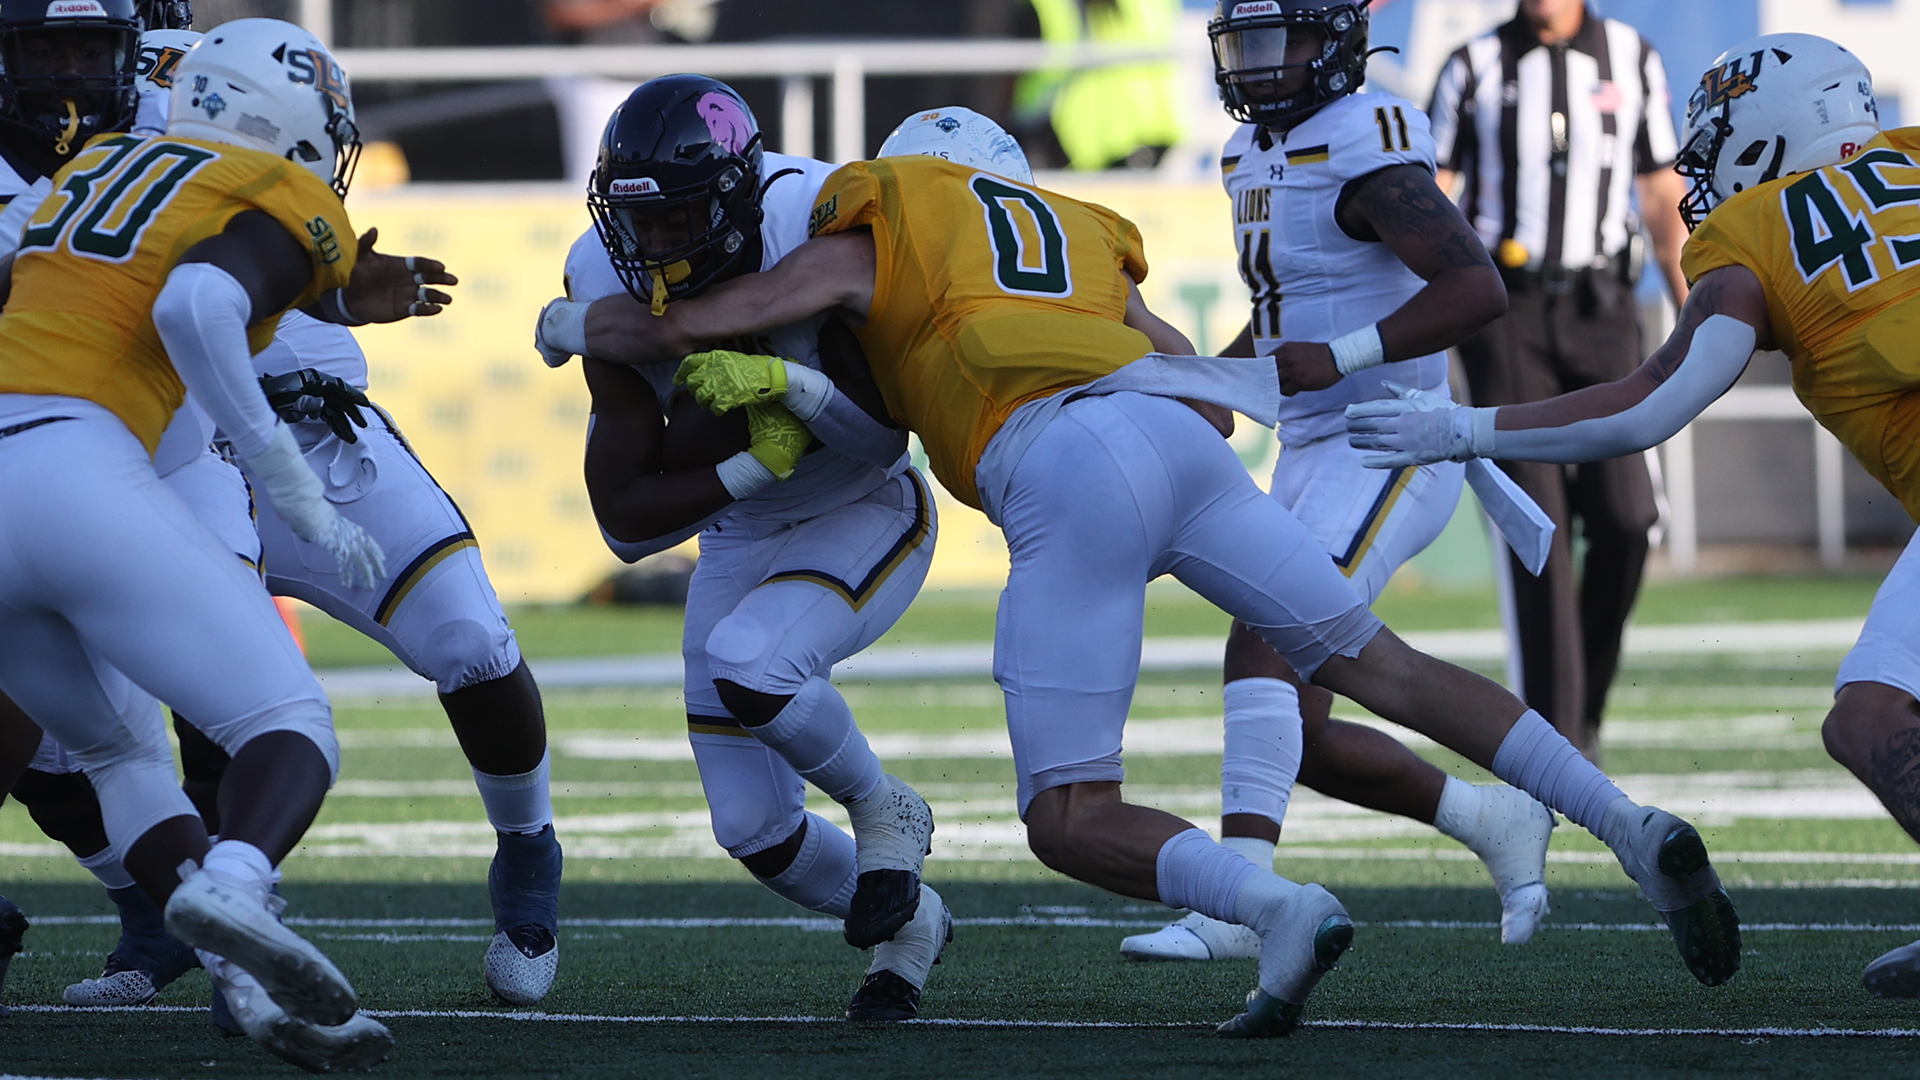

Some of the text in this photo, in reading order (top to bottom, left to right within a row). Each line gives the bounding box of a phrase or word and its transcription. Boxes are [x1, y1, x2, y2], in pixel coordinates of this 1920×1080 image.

[1236, 3, 1273, 14] Riddell
[136, 46, 186, 89] SL
[921, 112, 940, 122] 20
[1374, 105, 1411, 152] 11
[15, 134, 222, 264] 30
[612, 181, 650, 193] Riddell
[1237, 187, 1271, 224] LIONS
[610, 219, 638, 254] Riddell
[968, 171, 1074, 299] 0
[1241, 228, 1283, 339] 11
